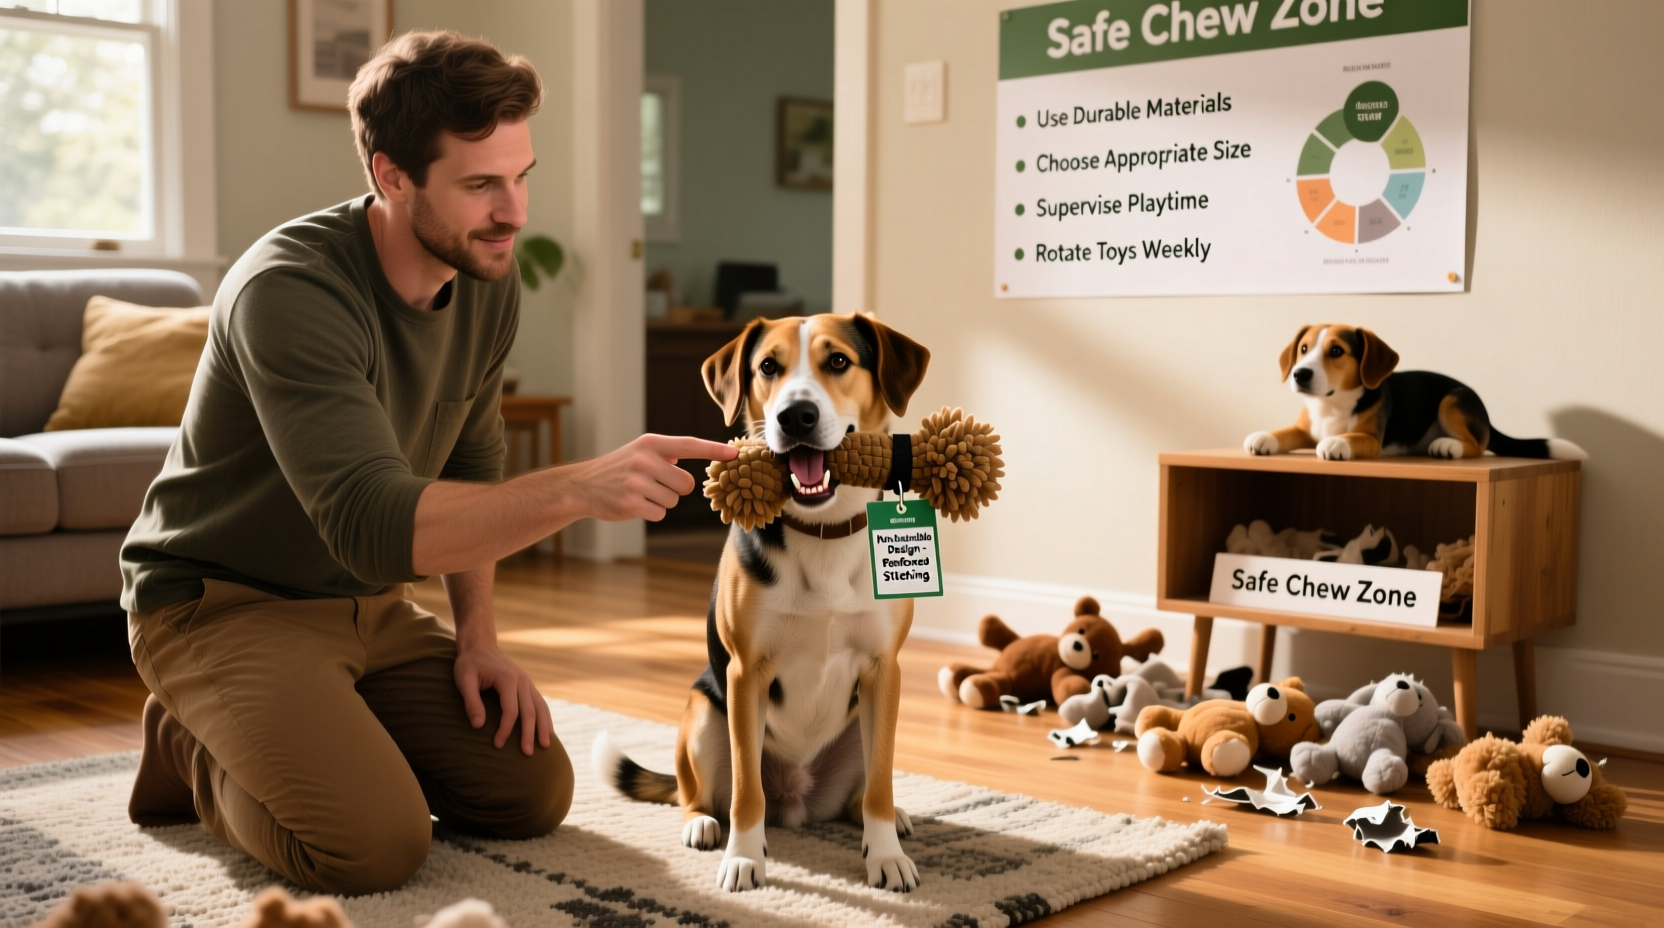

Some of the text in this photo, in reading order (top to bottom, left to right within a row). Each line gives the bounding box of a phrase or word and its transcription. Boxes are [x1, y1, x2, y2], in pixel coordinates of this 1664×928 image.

[1046, 0, 1384, 58] Safe Chew Zone
[1037, 92, 1232, 128] Use Durable Materials
[1036, 140, 1251, 173] Choose Appropriate Size
[1036, 190, 1209, 221] Supervise Playtime
[1036, 237, 1211, 265] Rotate Toys Weekly
[1231, 568, 1417, 608] Safe Chew Zone
